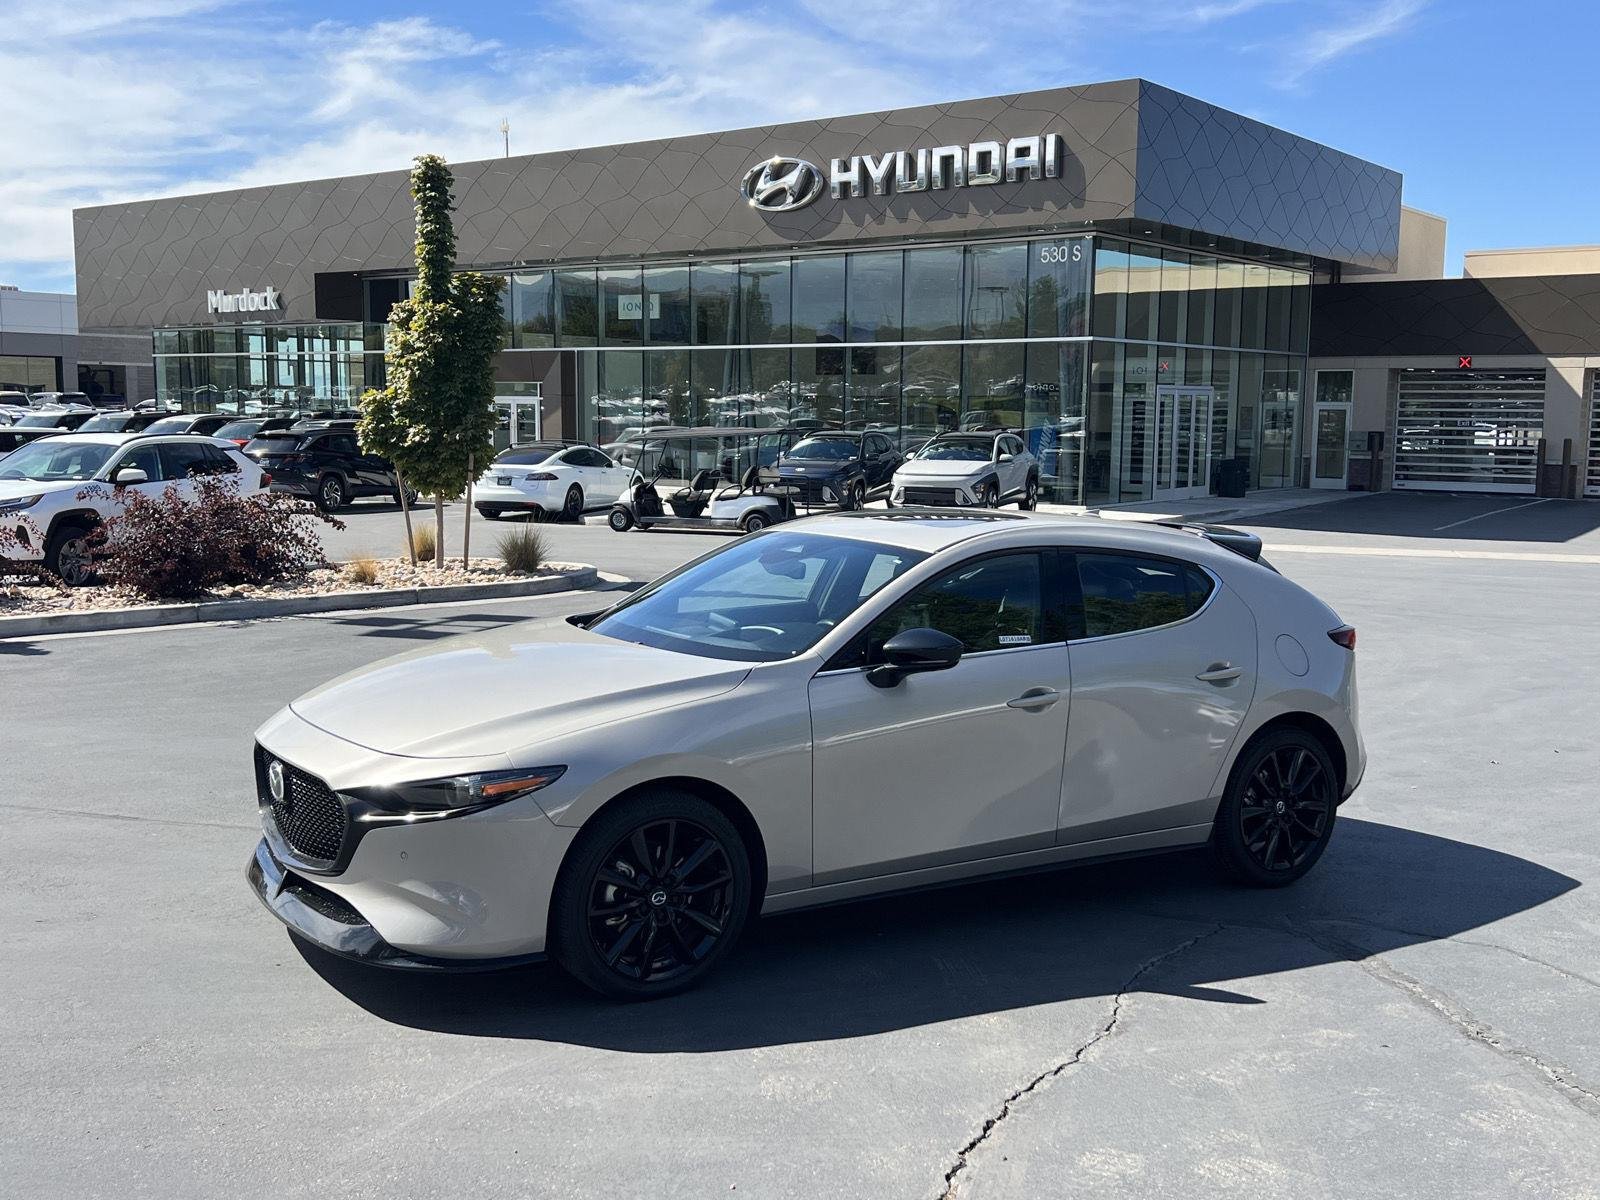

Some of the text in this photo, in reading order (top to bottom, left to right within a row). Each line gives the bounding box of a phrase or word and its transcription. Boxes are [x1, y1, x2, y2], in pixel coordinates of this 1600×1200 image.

[831, 133, 1062, 199] HYUNDAI
[1041, 245, 1081, 263] 530 S
[207, 286, 280, 313] Murdock
[622, 302, 654, 311] ION
